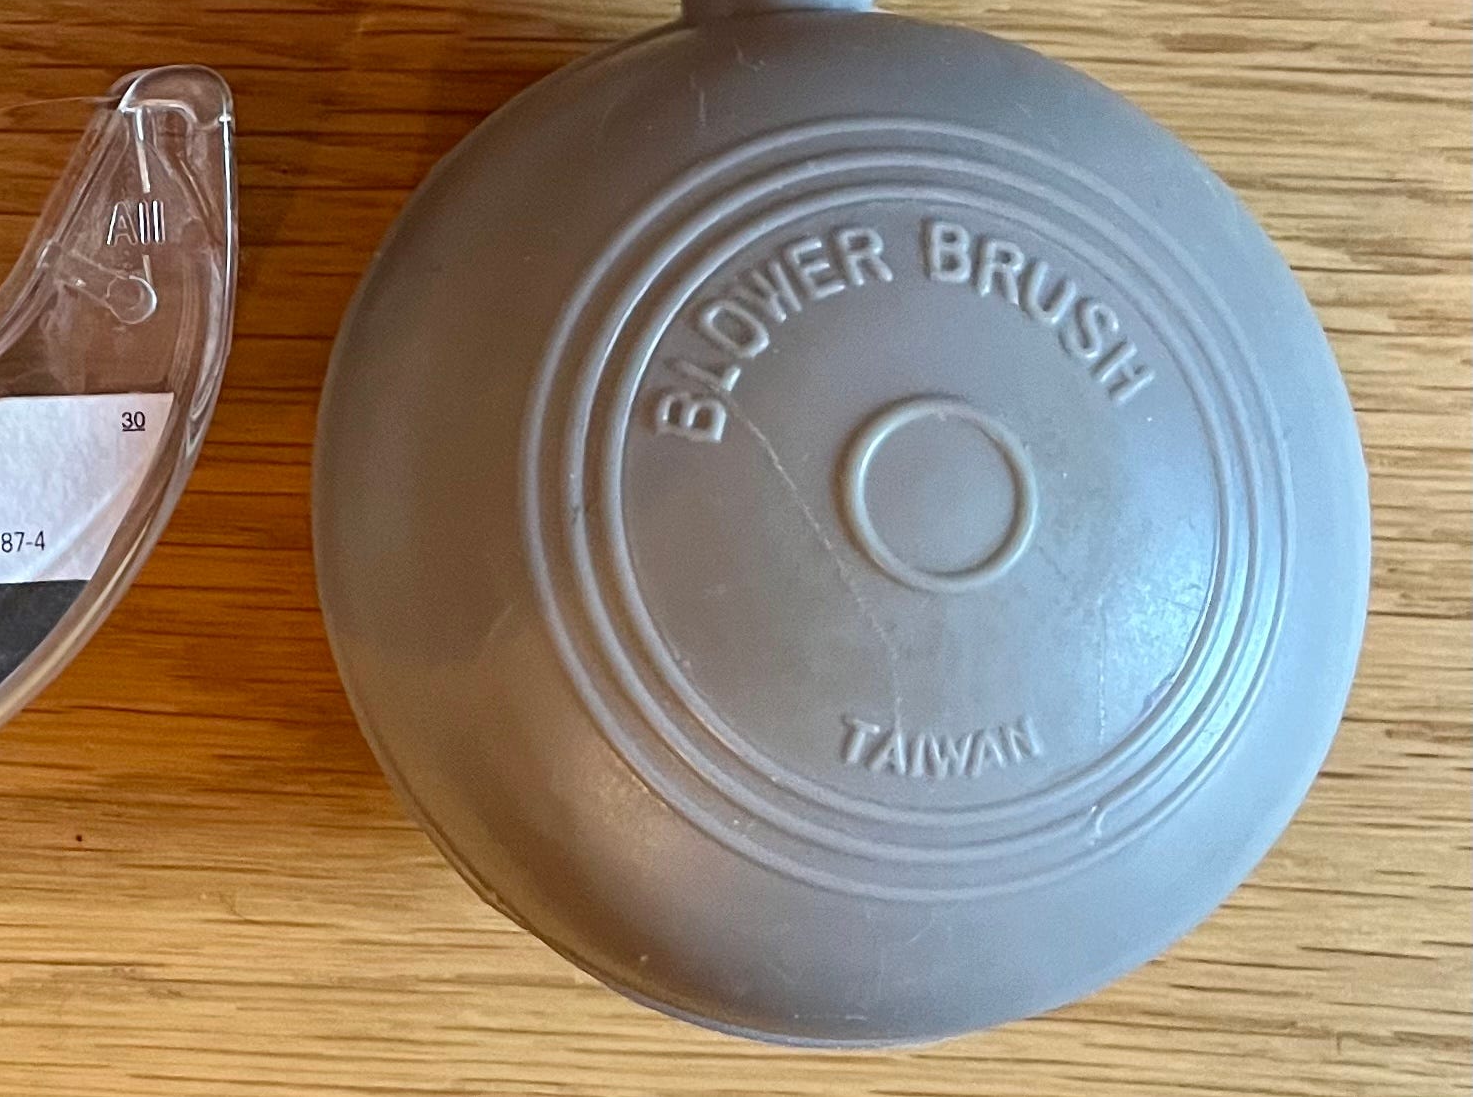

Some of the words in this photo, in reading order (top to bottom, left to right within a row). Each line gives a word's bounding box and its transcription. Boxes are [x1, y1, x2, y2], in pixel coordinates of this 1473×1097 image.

[654, 226, 893, 443] BLOWER
[924, 219, 1156, 408] BRUSH
[121, 411, 146, 430] 30
[841, 716, 1046, 777] TAIWAN
